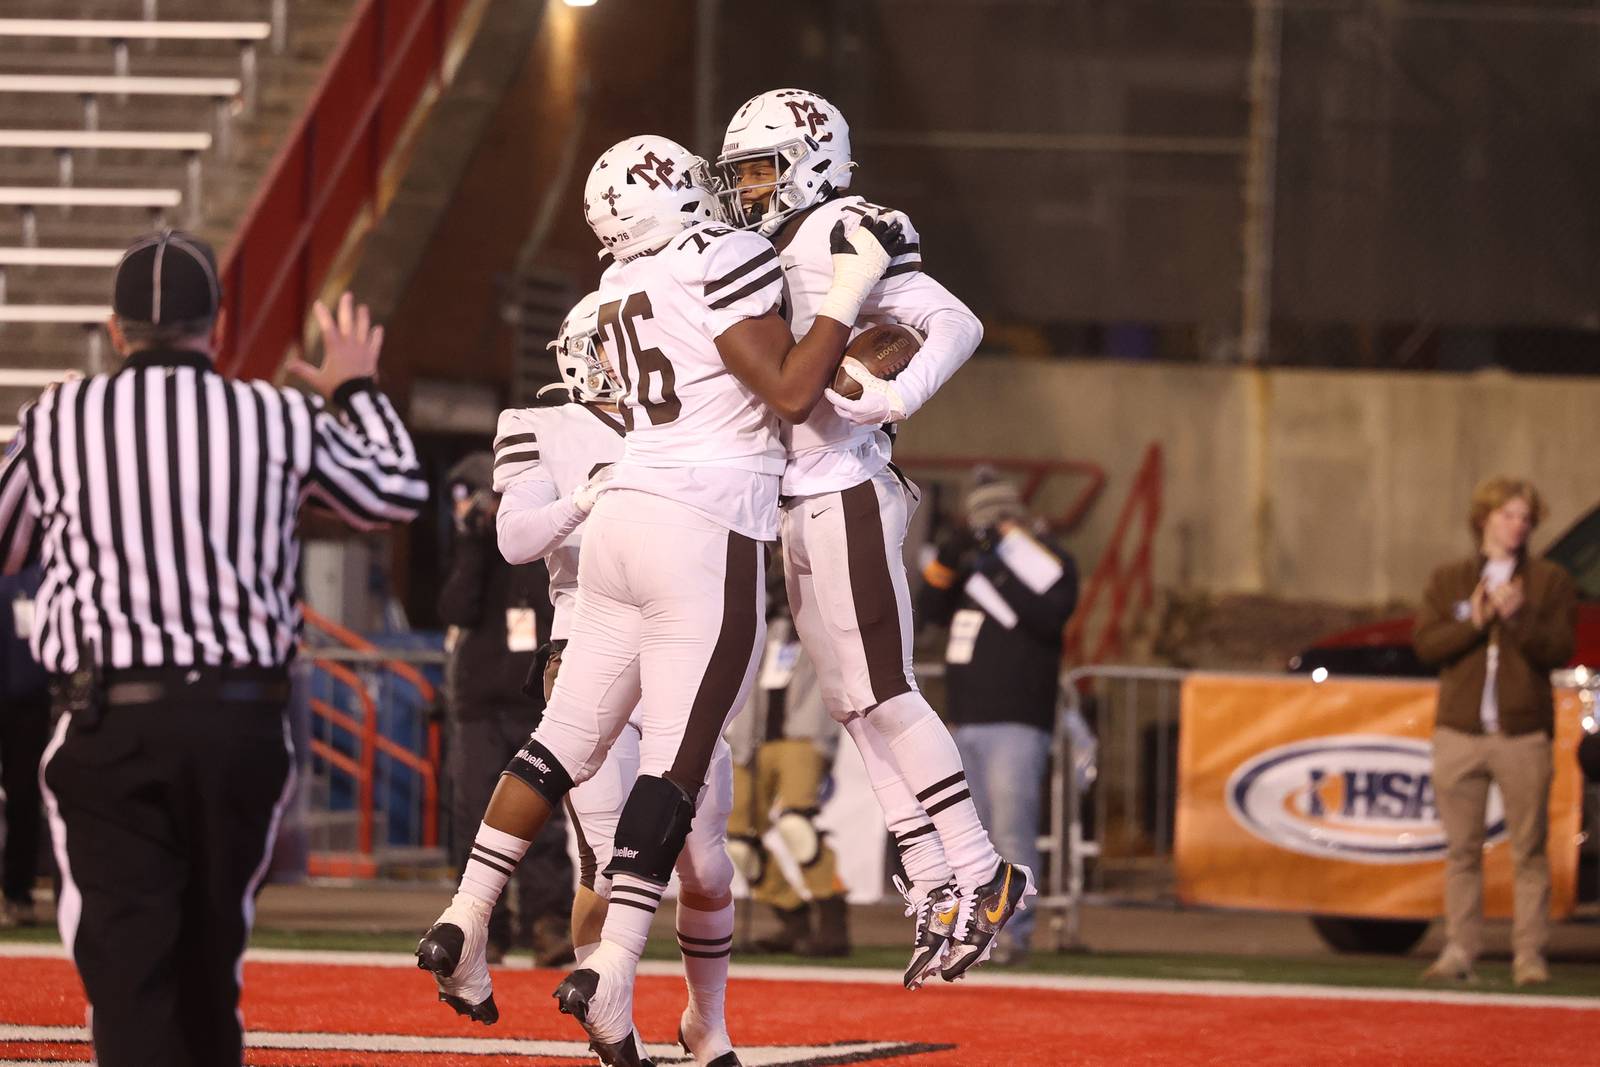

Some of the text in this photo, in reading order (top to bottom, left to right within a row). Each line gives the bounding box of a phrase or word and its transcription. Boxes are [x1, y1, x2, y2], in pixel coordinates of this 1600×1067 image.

[617, 232, 630, 242] 76
[677, 227, 736, 254] 76
[597, 291, 682, 432] 76
[515, 749, 552, 774] Mueller
